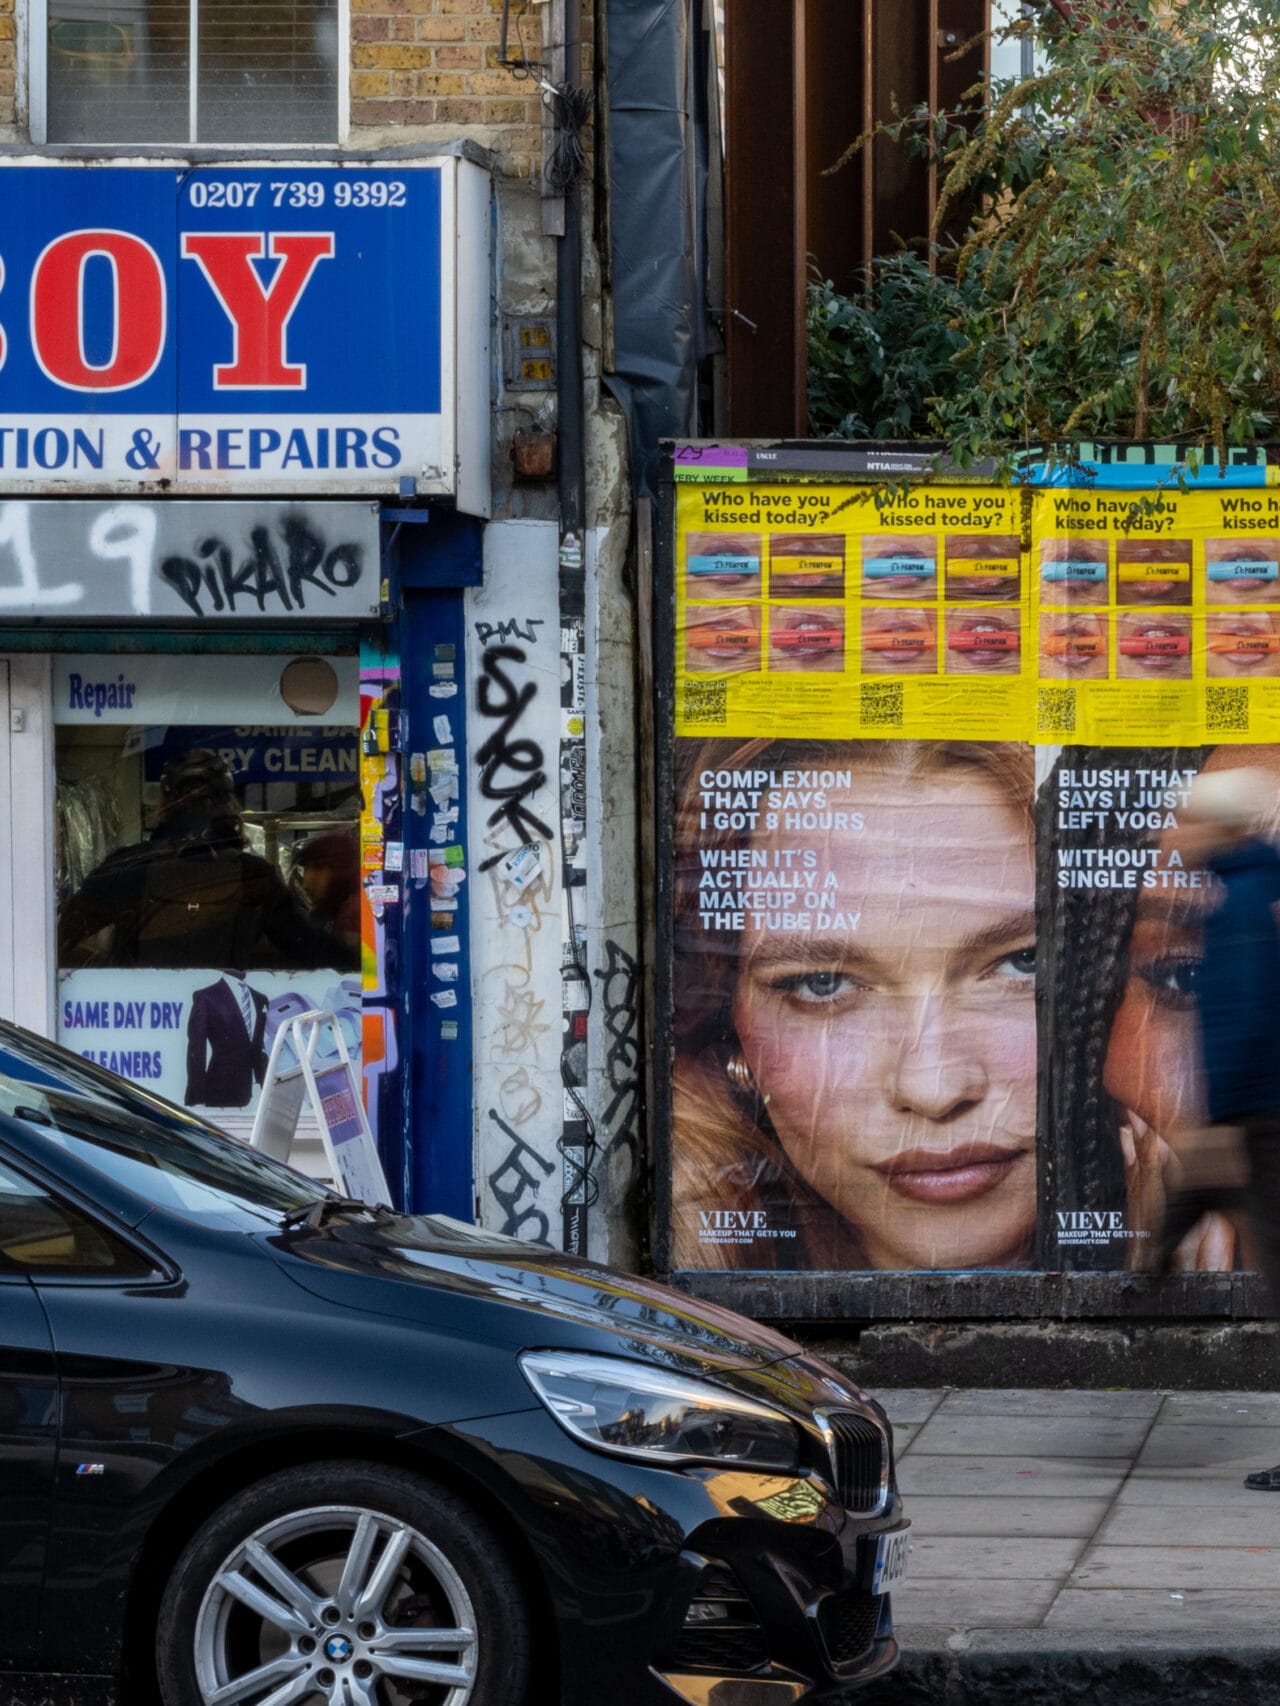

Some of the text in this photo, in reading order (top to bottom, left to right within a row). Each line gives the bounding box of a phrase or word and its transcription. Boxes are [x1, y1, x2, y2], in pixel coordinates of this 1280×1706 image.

[189, 181, 407, 208] 0207 739 9392
[0, 227, 335, 394] OY
[125, 426, 161, 471] &
[179, 426, 402, 471] REPAIRS
[756, 452, 777, 460] UNCLE
[867, 462, 891, 471] NTIA
[703, 491, 830, 510] Who have you
[1220, 498, 1262, 512] Who
[704, 509, 829, 526] kissed today?
[1223, 515, 1280, 529] kissed
[68, 672, 136, 717] Repair
[699, 770, 852, 789] COMPLEXION
[1058, 769, 1197, 789] BLUSH THAT
[700, 791, 827, 810] THAT SAYS
[1058, 791, 1191, 809] SAYS I JUST
[700, 812, 864, 830] I GOT 8 HOURS
[1058, 812, 1179, 830] LEFT YOGA
[699, 850, 816, 868] WHEN IT'S
[1058, 849, 1184, 868] WITHOUT A
[699, 870, 839, 889] ACTUALLY A
[1057, 870, 1138, 889] SINGLE
[699, 891, 836, 910] MAKEUP ON
[700, 912, 862, 931] THE TUBE DAY
[64, 1001, 184, 1029] SAME DAY DRY
[699, 1211, 767, 1229] VIEVE
